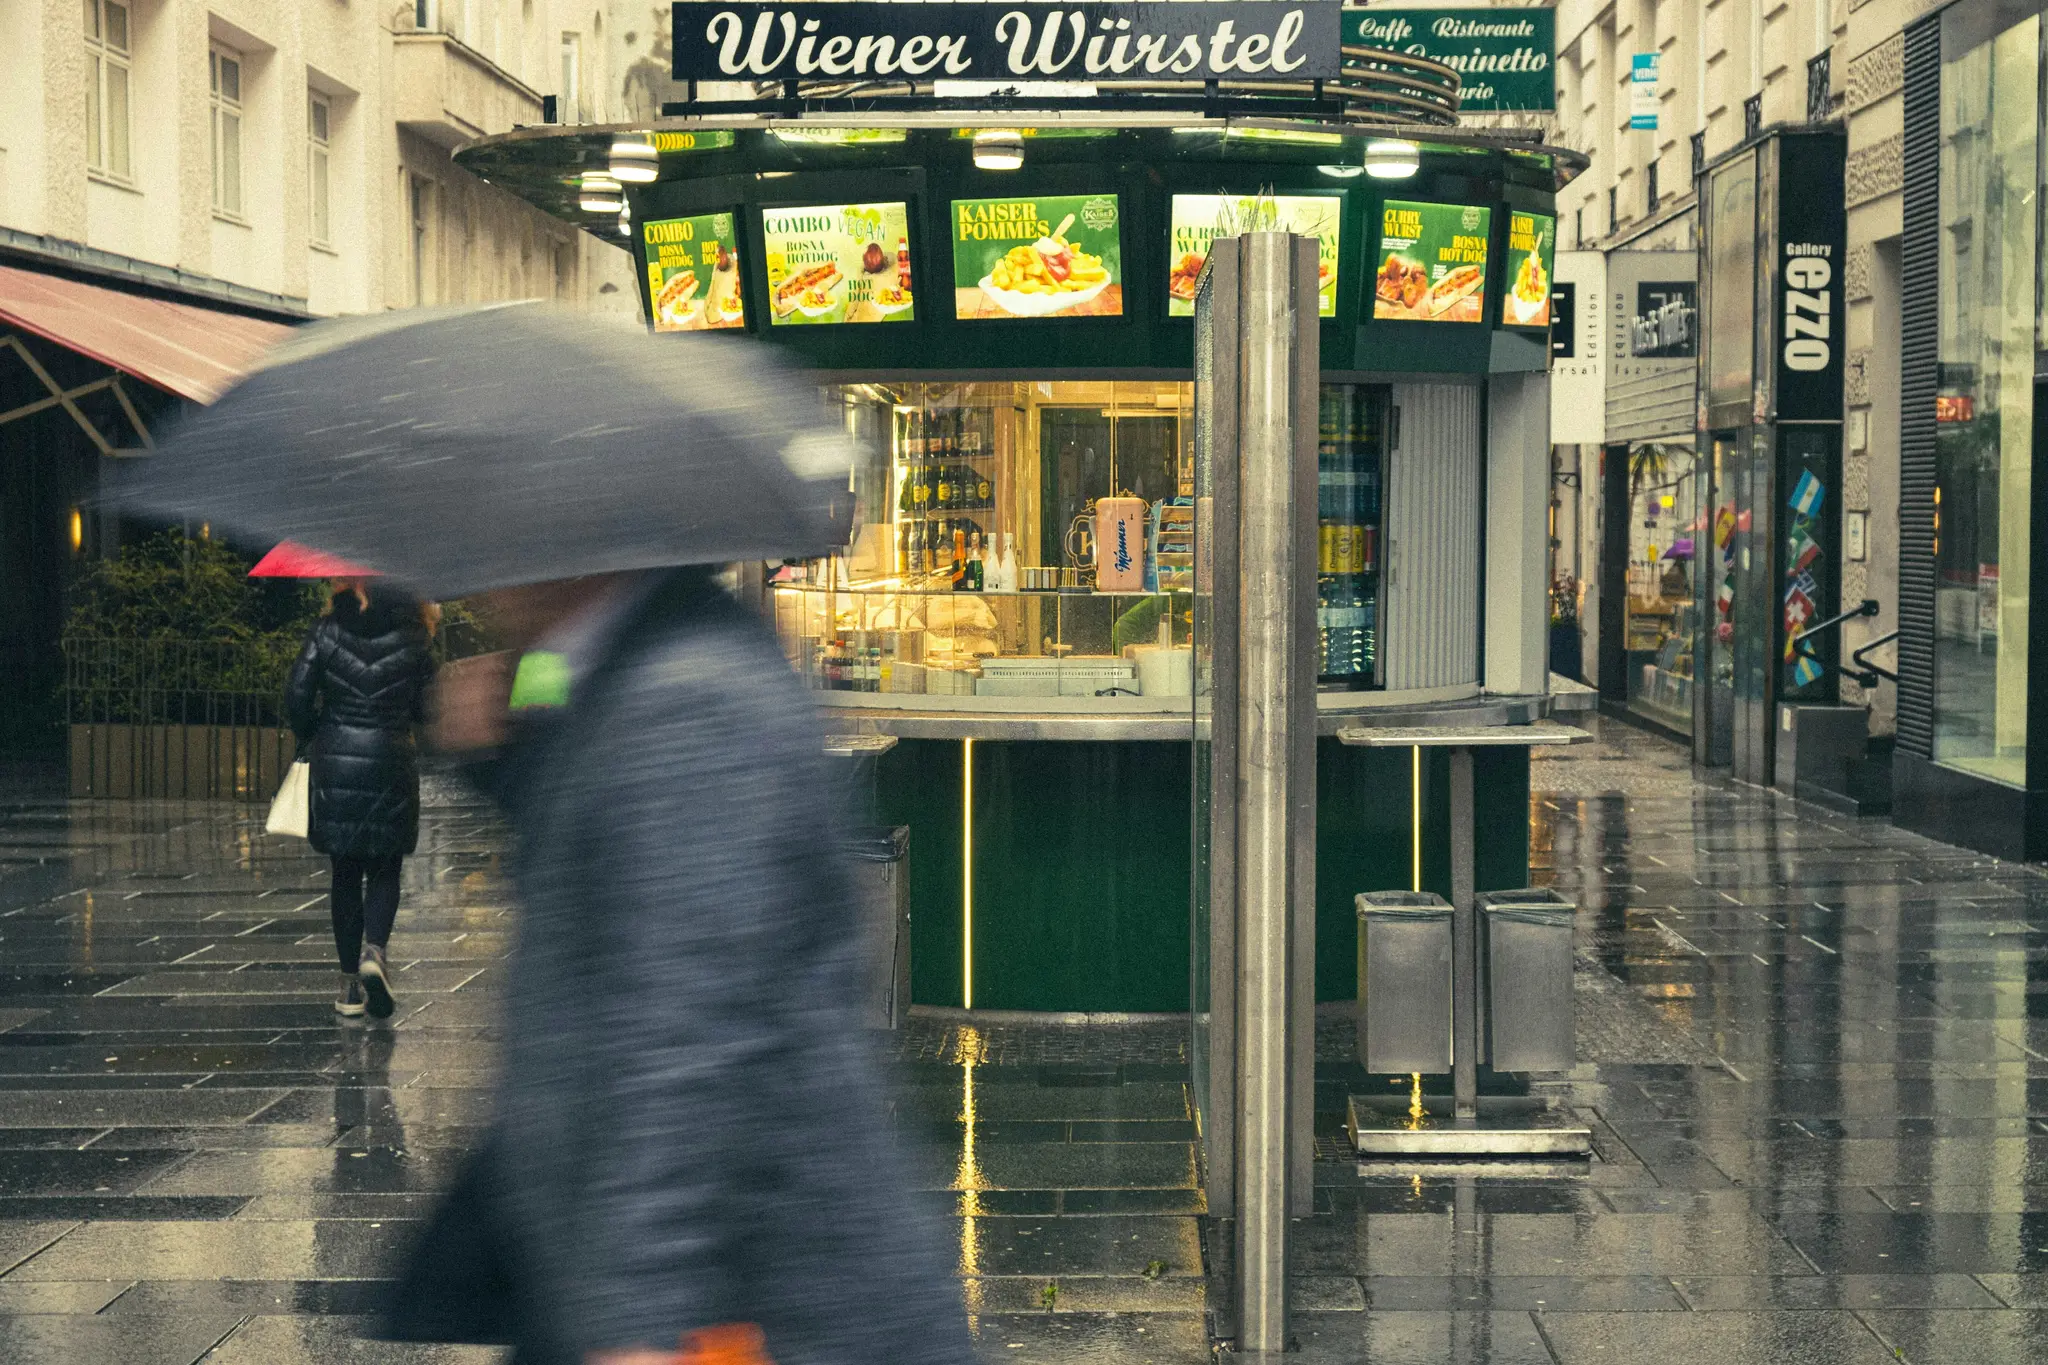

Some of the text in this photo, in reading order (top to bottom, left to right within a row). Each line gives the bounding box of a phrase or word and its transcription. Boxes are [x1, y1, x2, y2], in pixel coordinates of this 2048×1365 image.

[1359, 17, 1535, 42] Caffe Ristorante
[706, 9, 1308, 74] Wiener Würstel
[957, 203, 1038, 223] KAISER
[1384, 209, 1421, 225] CURRY
[644, 221, 694, 245] COMBO
[765, 216, 831, 235] COMBO
[838, 216, 886, 241] VEGAN
[959, 220, 1050, 241] POMMES
[1384, 222, 1423, 239] WURST
[658, 244, 685, 257] BOSNA
[701, 240, 719, 253] HOT
[786, 240, 825, 252] BOSNA
[1452, 235, 1487, 250] BOSNA
[1786, 242, 1832, 257] Gallery
[702, 252, 720, 265] DOG
[1439, 247, 1487, 263] HOT DOG
[848, 279, 874, 290] HOT
[848, 291, 874, 303] DOG
[1587, 293, 1598, 359] Edition
[1113, 518, 1132, 573] Manner
